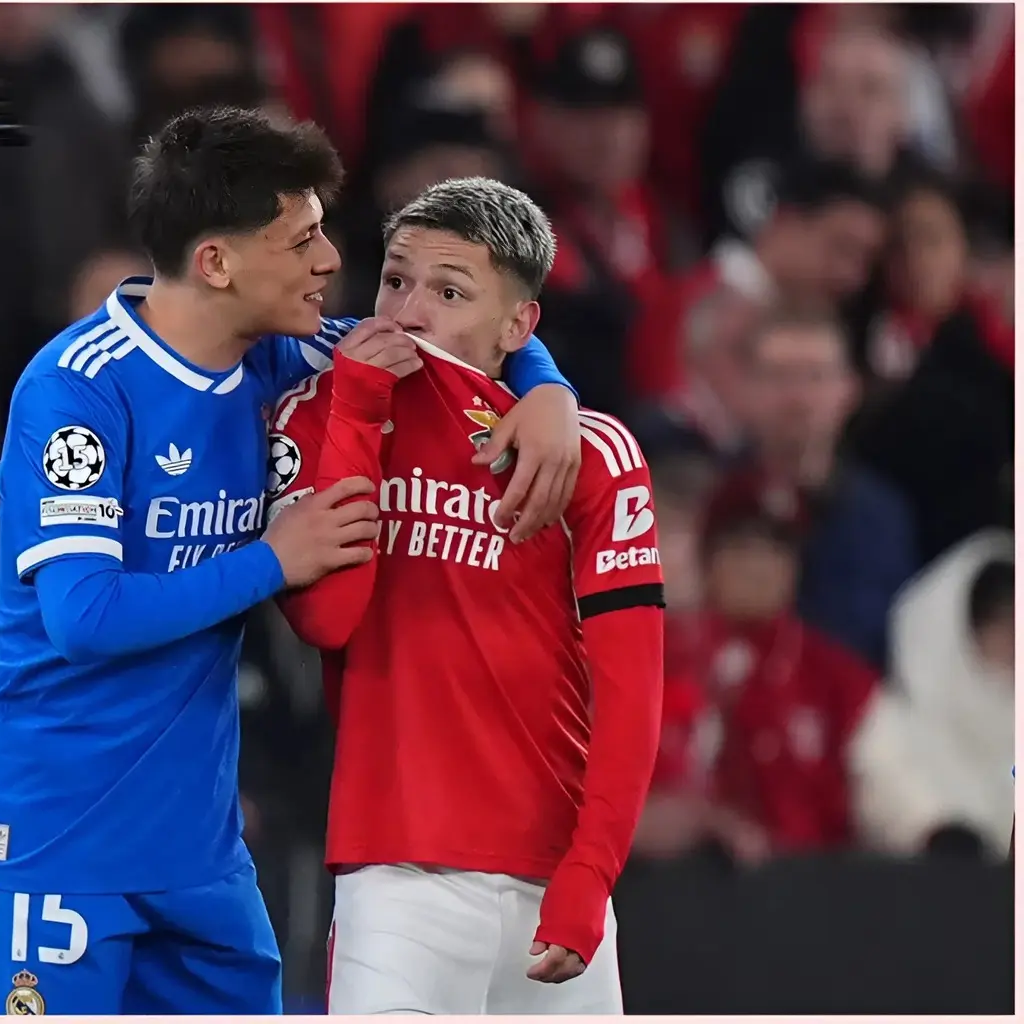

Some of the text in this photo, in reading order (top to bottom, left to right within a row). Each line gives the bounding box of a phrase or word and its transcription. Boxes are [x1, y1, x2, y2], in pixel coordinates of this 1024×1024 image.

[58, 445, 89, 471] 15
[145, 489, 266, 538] Emirat
[379, 467, 514, 534] mirat
[408, 521, 505, 571] BETTER
[596, 547, 661, 574] Betan
[11, 892, 88, 965] 15
